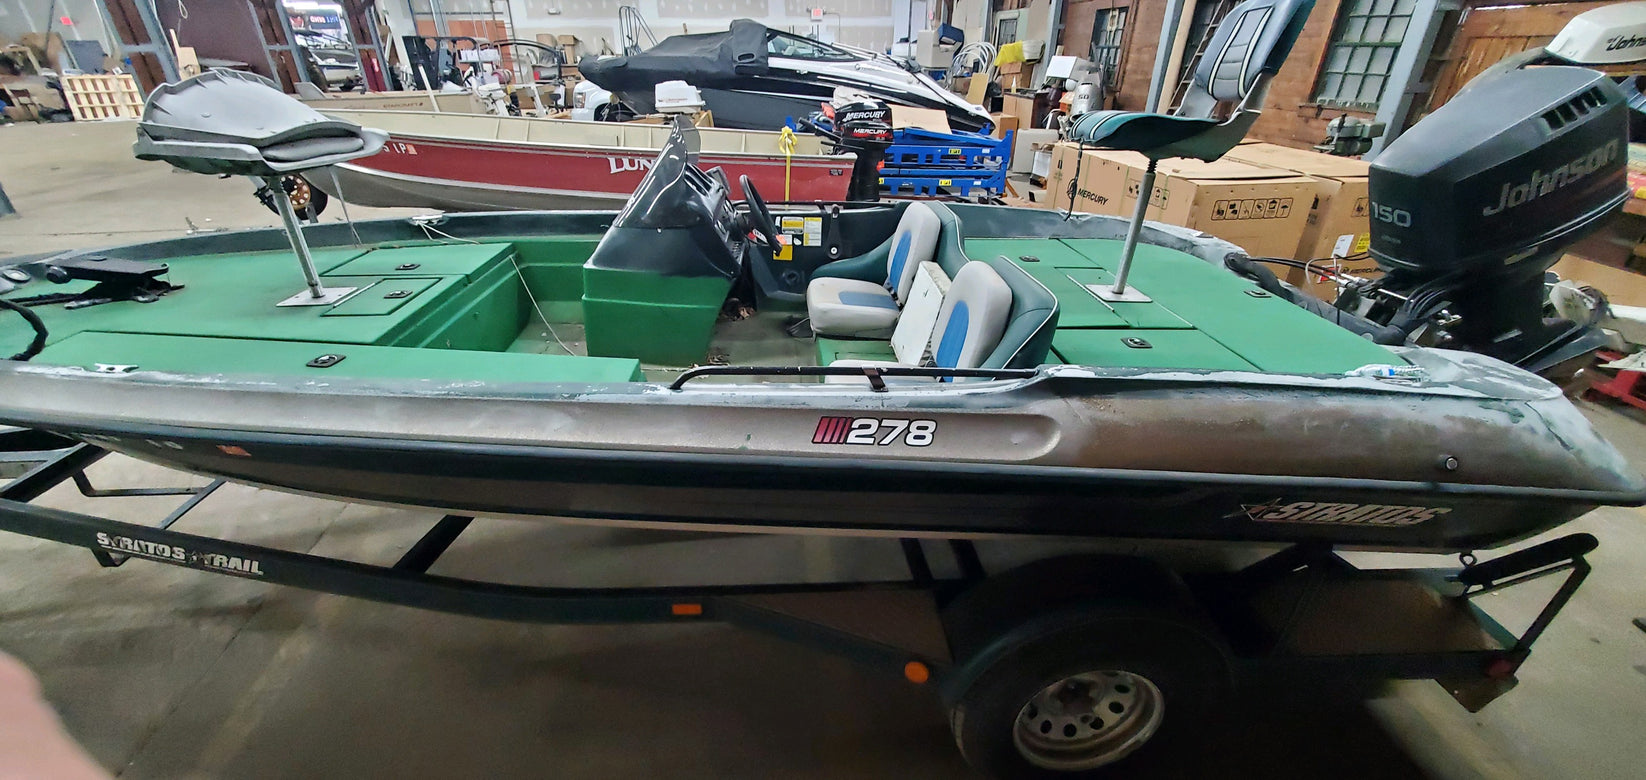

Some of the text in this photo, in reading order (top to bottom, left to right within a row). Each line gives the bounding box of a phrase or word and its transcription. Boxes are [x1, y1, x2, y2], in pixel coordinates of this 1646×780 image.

[842, 110, 886, 123] MERCURY
[853, 127, 888, 135] MERCURY
[1482, 138, 1619, 217] Johnson
[1077, 188, 1109, 206] MERCURY
[1371, 201, 1412, 228] 150
[845, 417, 938, 446] 278
[1262, 501, 1453, 527] STRATOS
[97, 532, 186, 561] STRATOS
